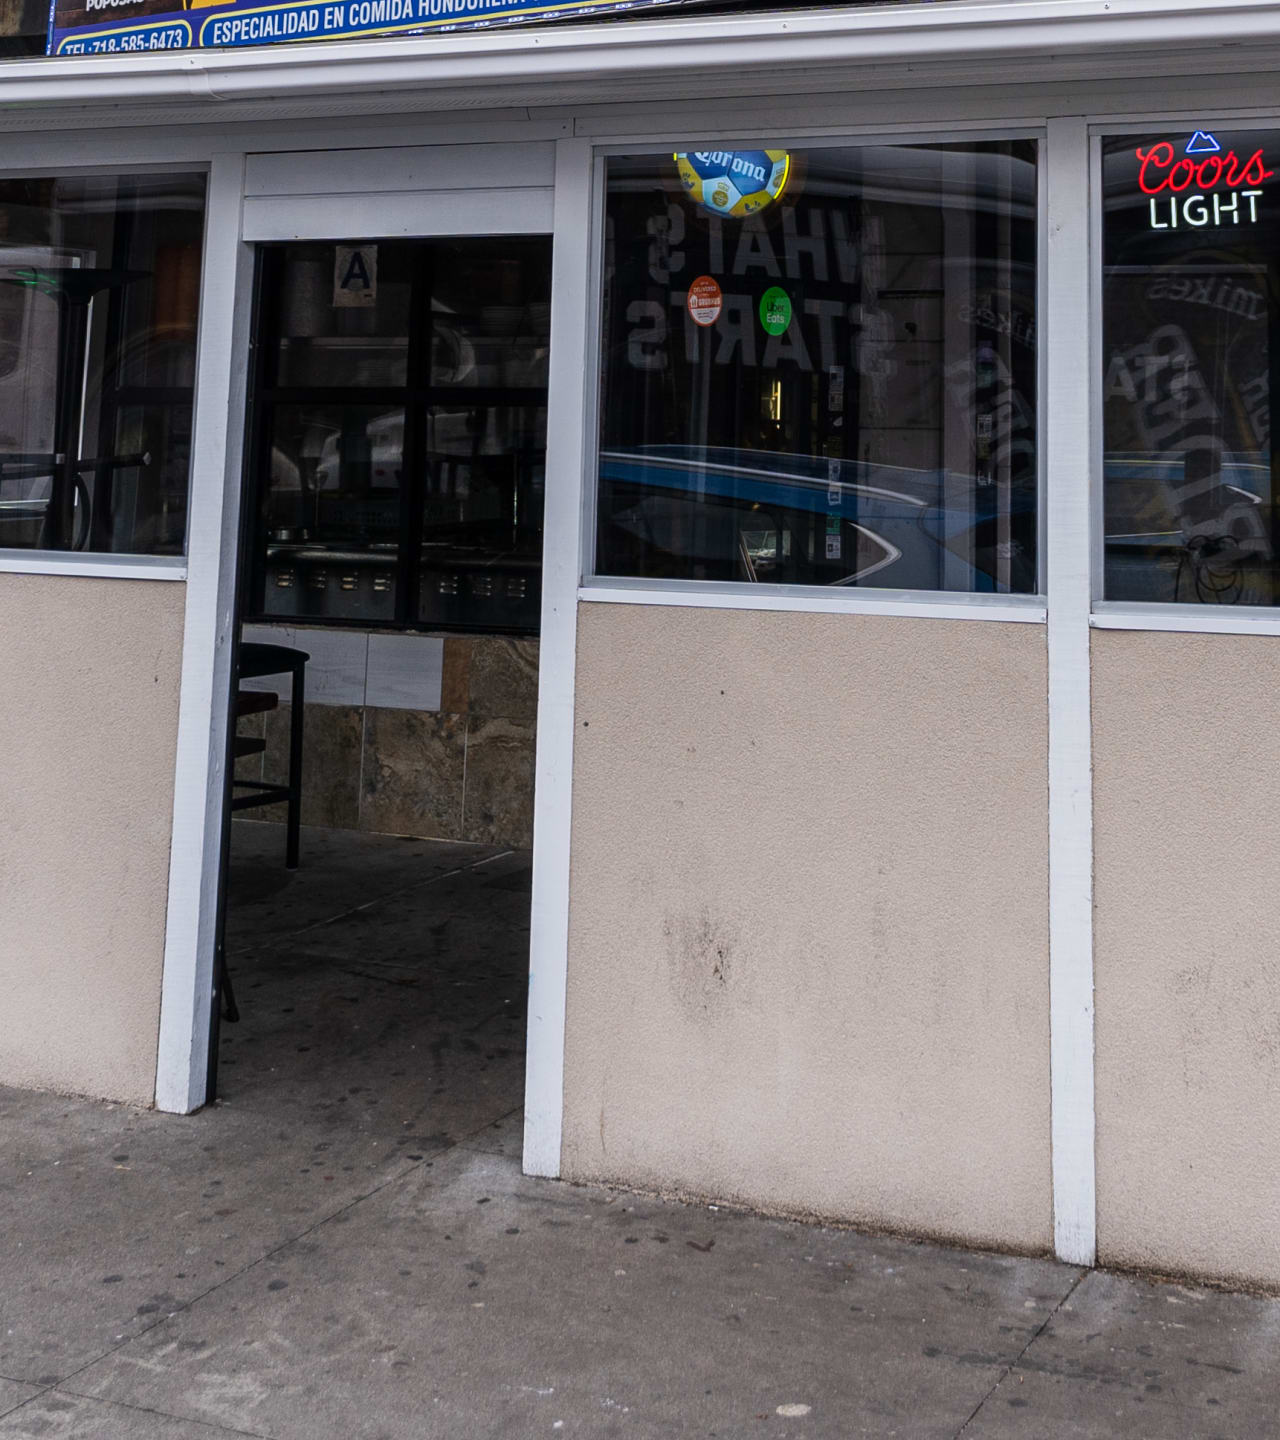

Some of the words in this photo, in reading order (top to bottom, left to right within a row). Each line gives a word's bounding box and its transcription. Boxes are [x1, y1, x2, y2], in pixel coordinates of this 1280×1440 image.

[213, 10, 319, 44] ESPECIALIDAD
[323, 5, 344, 28] EN
[1136, 140, 1273, 194] Coors
[1149, 190, 1263, 229] LIGHT
[341, 252, 370, 289] A
[766, 312, 785, 323] Eats
